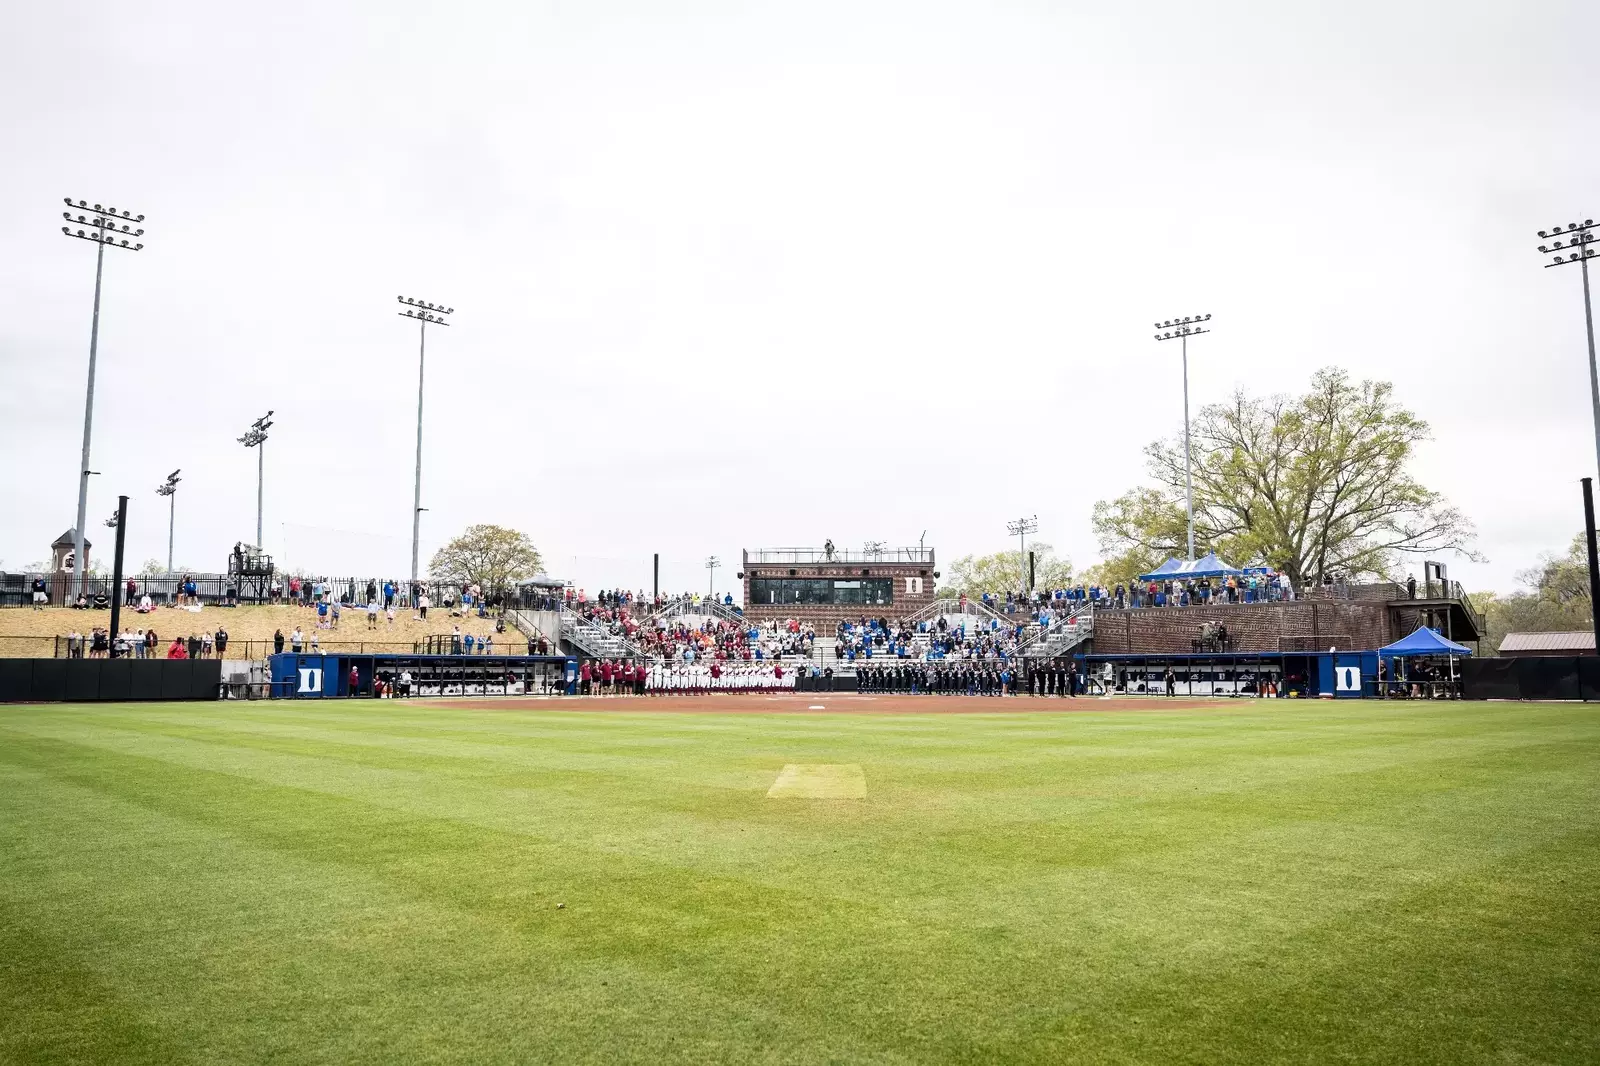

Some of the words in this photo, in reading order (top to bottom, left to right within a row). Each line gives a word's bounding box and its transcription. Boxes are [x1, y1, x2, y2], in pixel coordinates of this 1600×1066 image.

[904, 577, 923, 593] D
[297, 668, 322, 692] D
[1335, 666, 1361, 690] D
